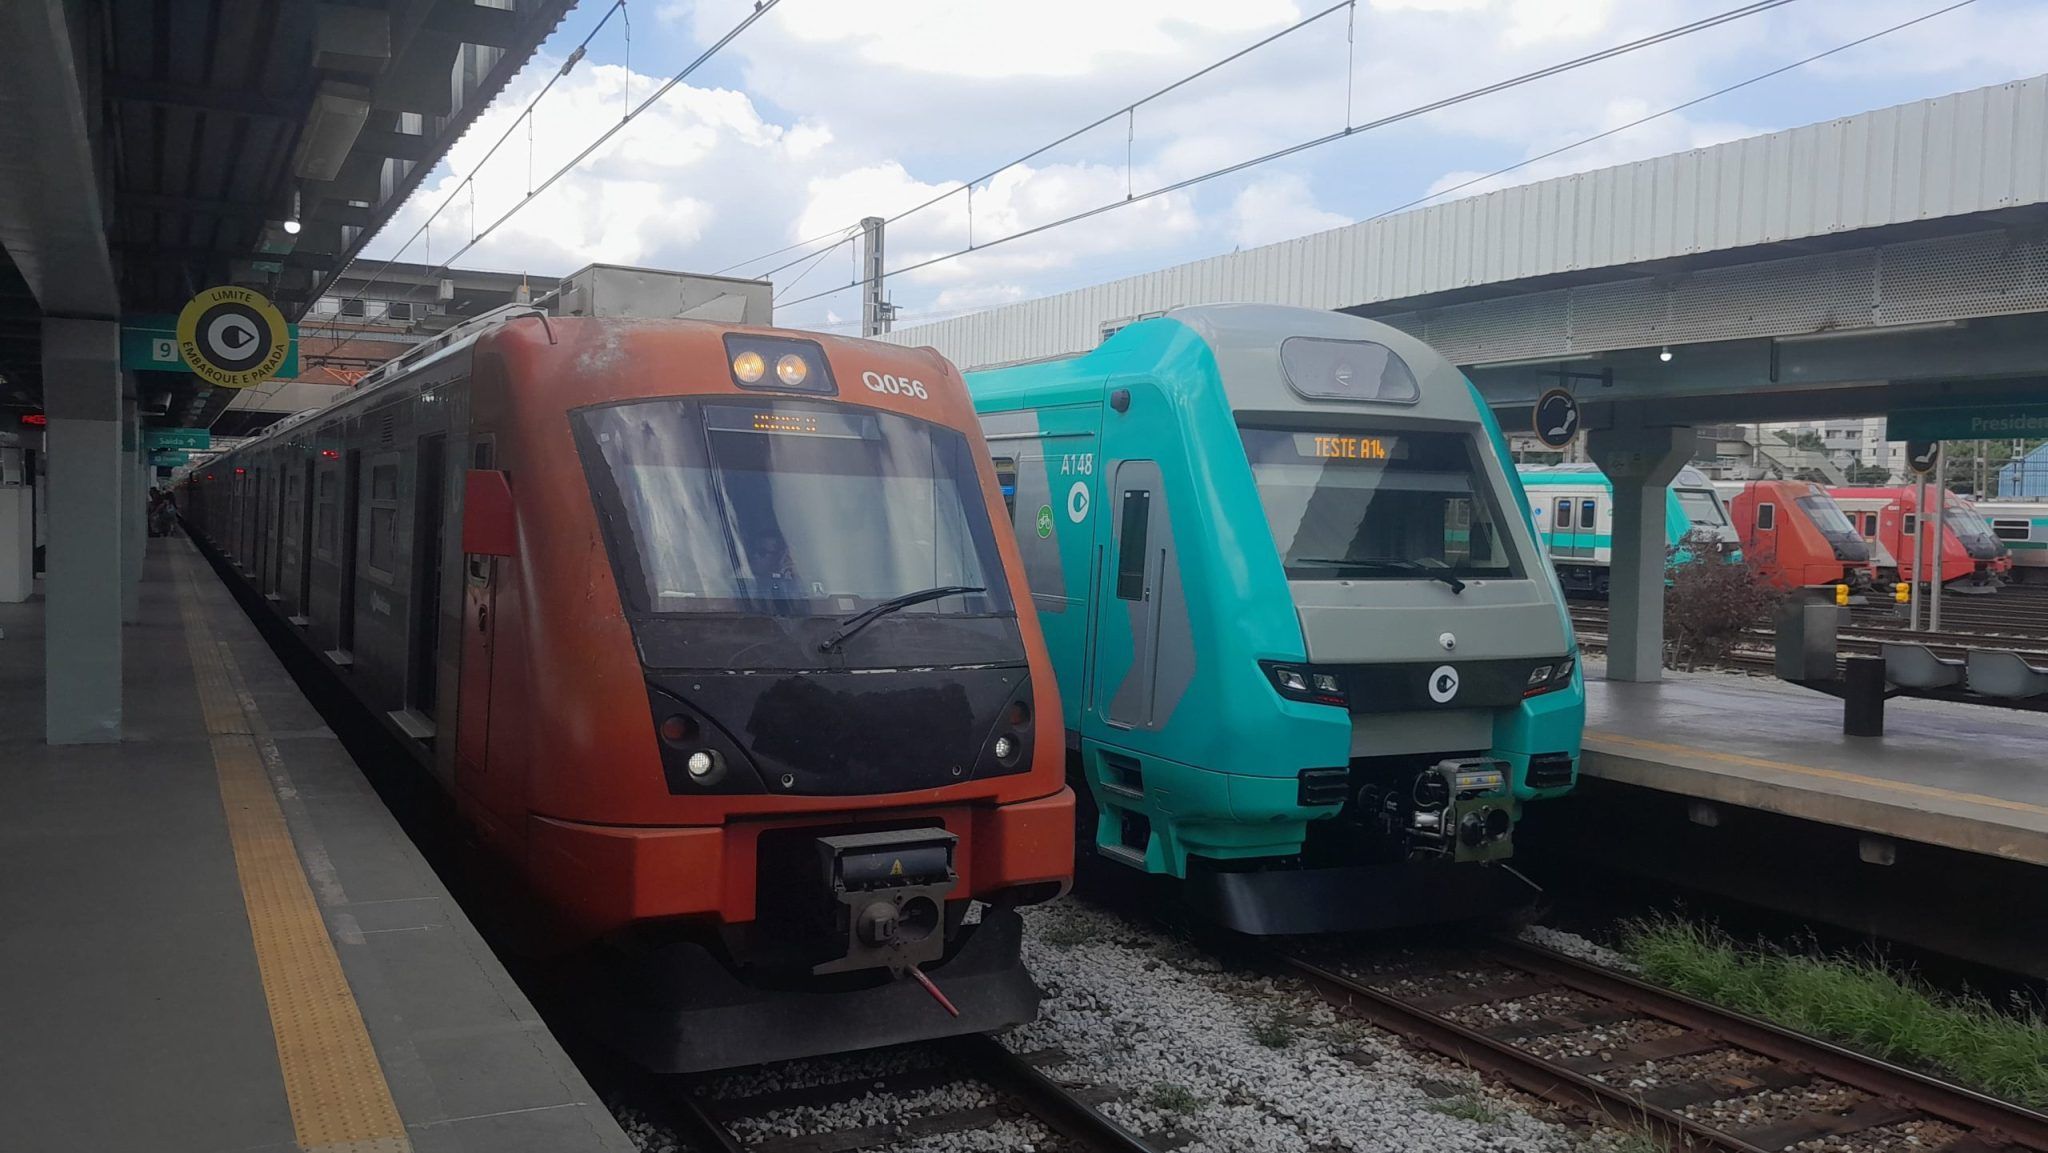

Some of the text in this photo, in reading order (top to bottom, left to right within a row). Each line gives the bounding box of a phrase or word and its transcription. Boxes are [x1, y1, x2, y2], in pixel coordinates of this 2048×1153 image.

[211, 290, 253, 303] LIMITE
[159, 342, 171, 359] 9
[183, 341, 286, 385] EMBARQUE E PARADA
[862, 371, 928, 400] Q056
[1314, 436, 1386, 459] TESTE A14
[1060, 454, 1093, 476] A148
